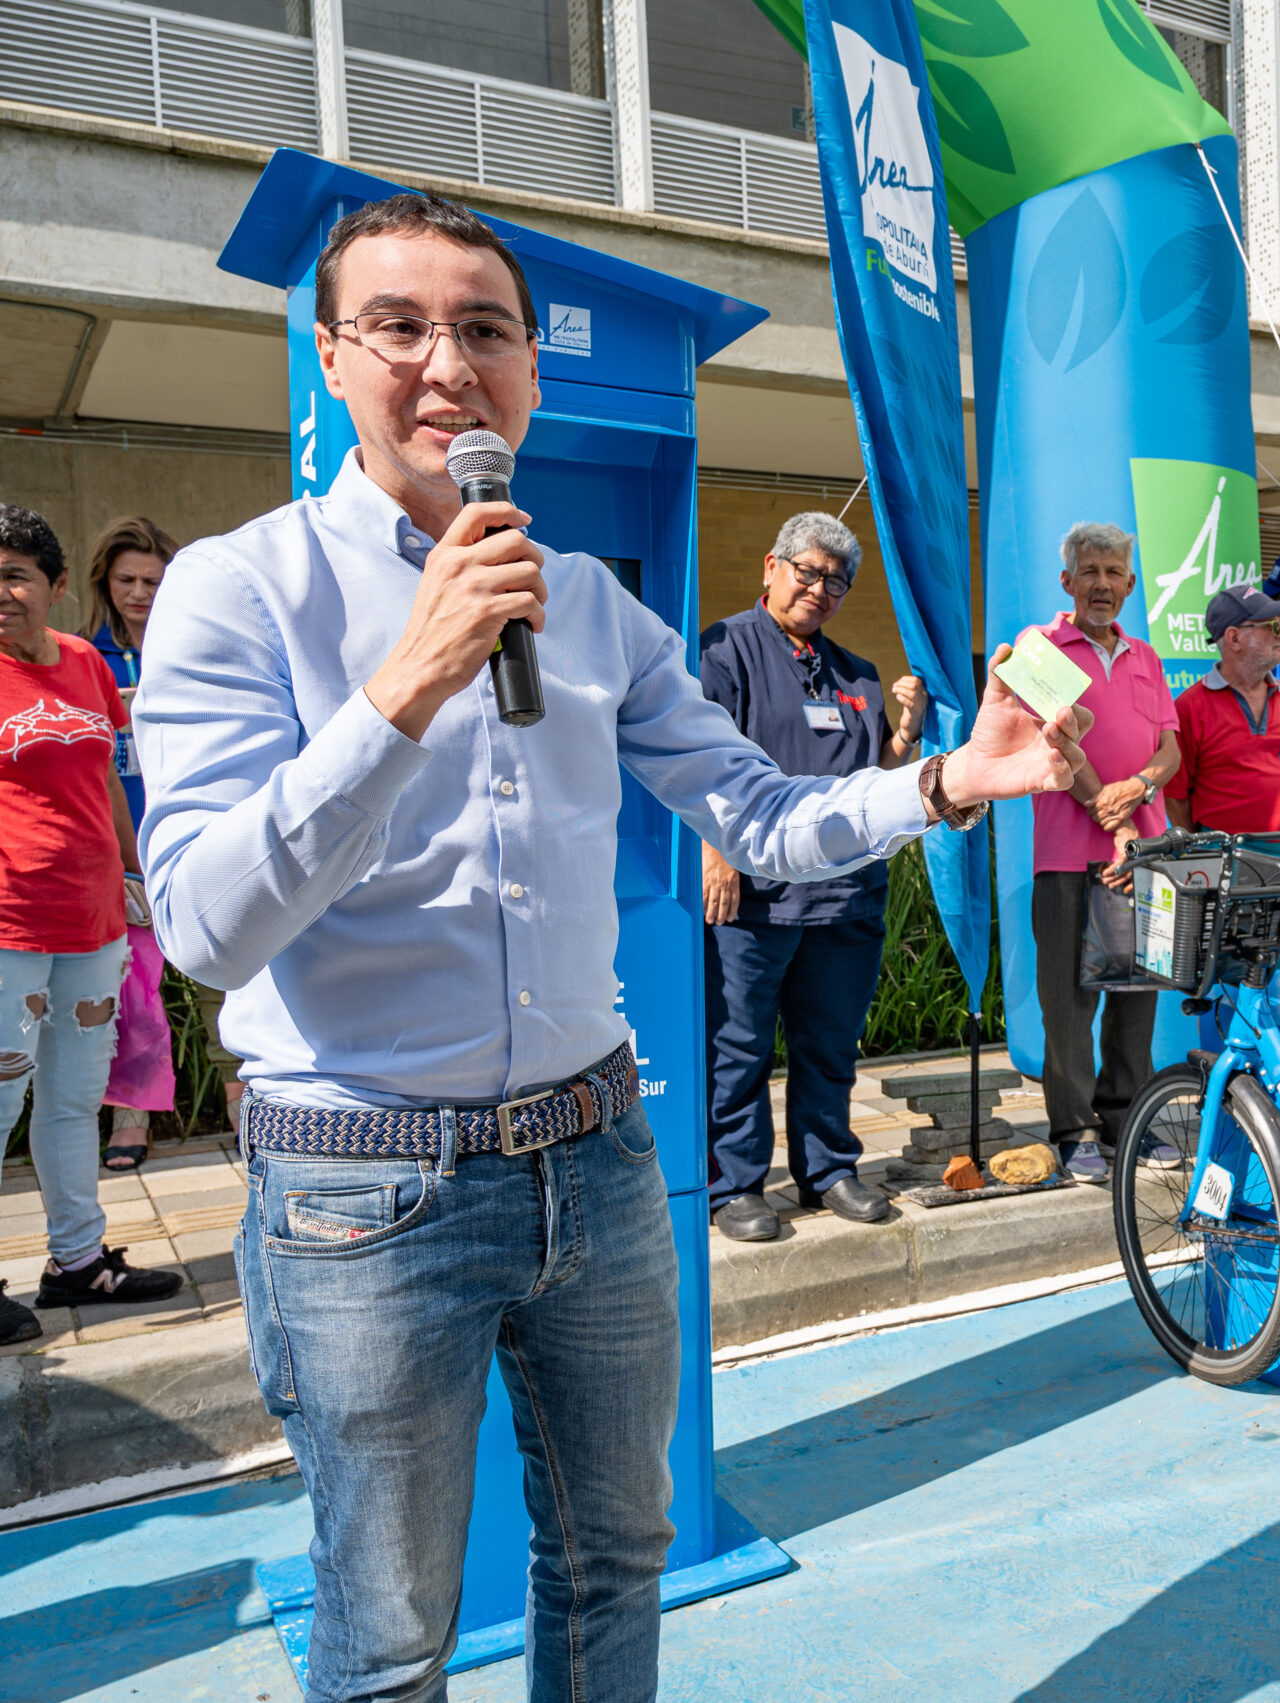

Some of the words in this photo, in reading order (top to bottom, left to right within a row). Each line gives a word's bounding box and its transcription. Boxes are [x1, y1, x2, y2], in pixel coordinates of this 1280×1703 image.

[1147, 476, 1262, 624] Área
[639, 1079, 667, 1097] Sur
[1204, 1173, 1227, 1211] 3004
